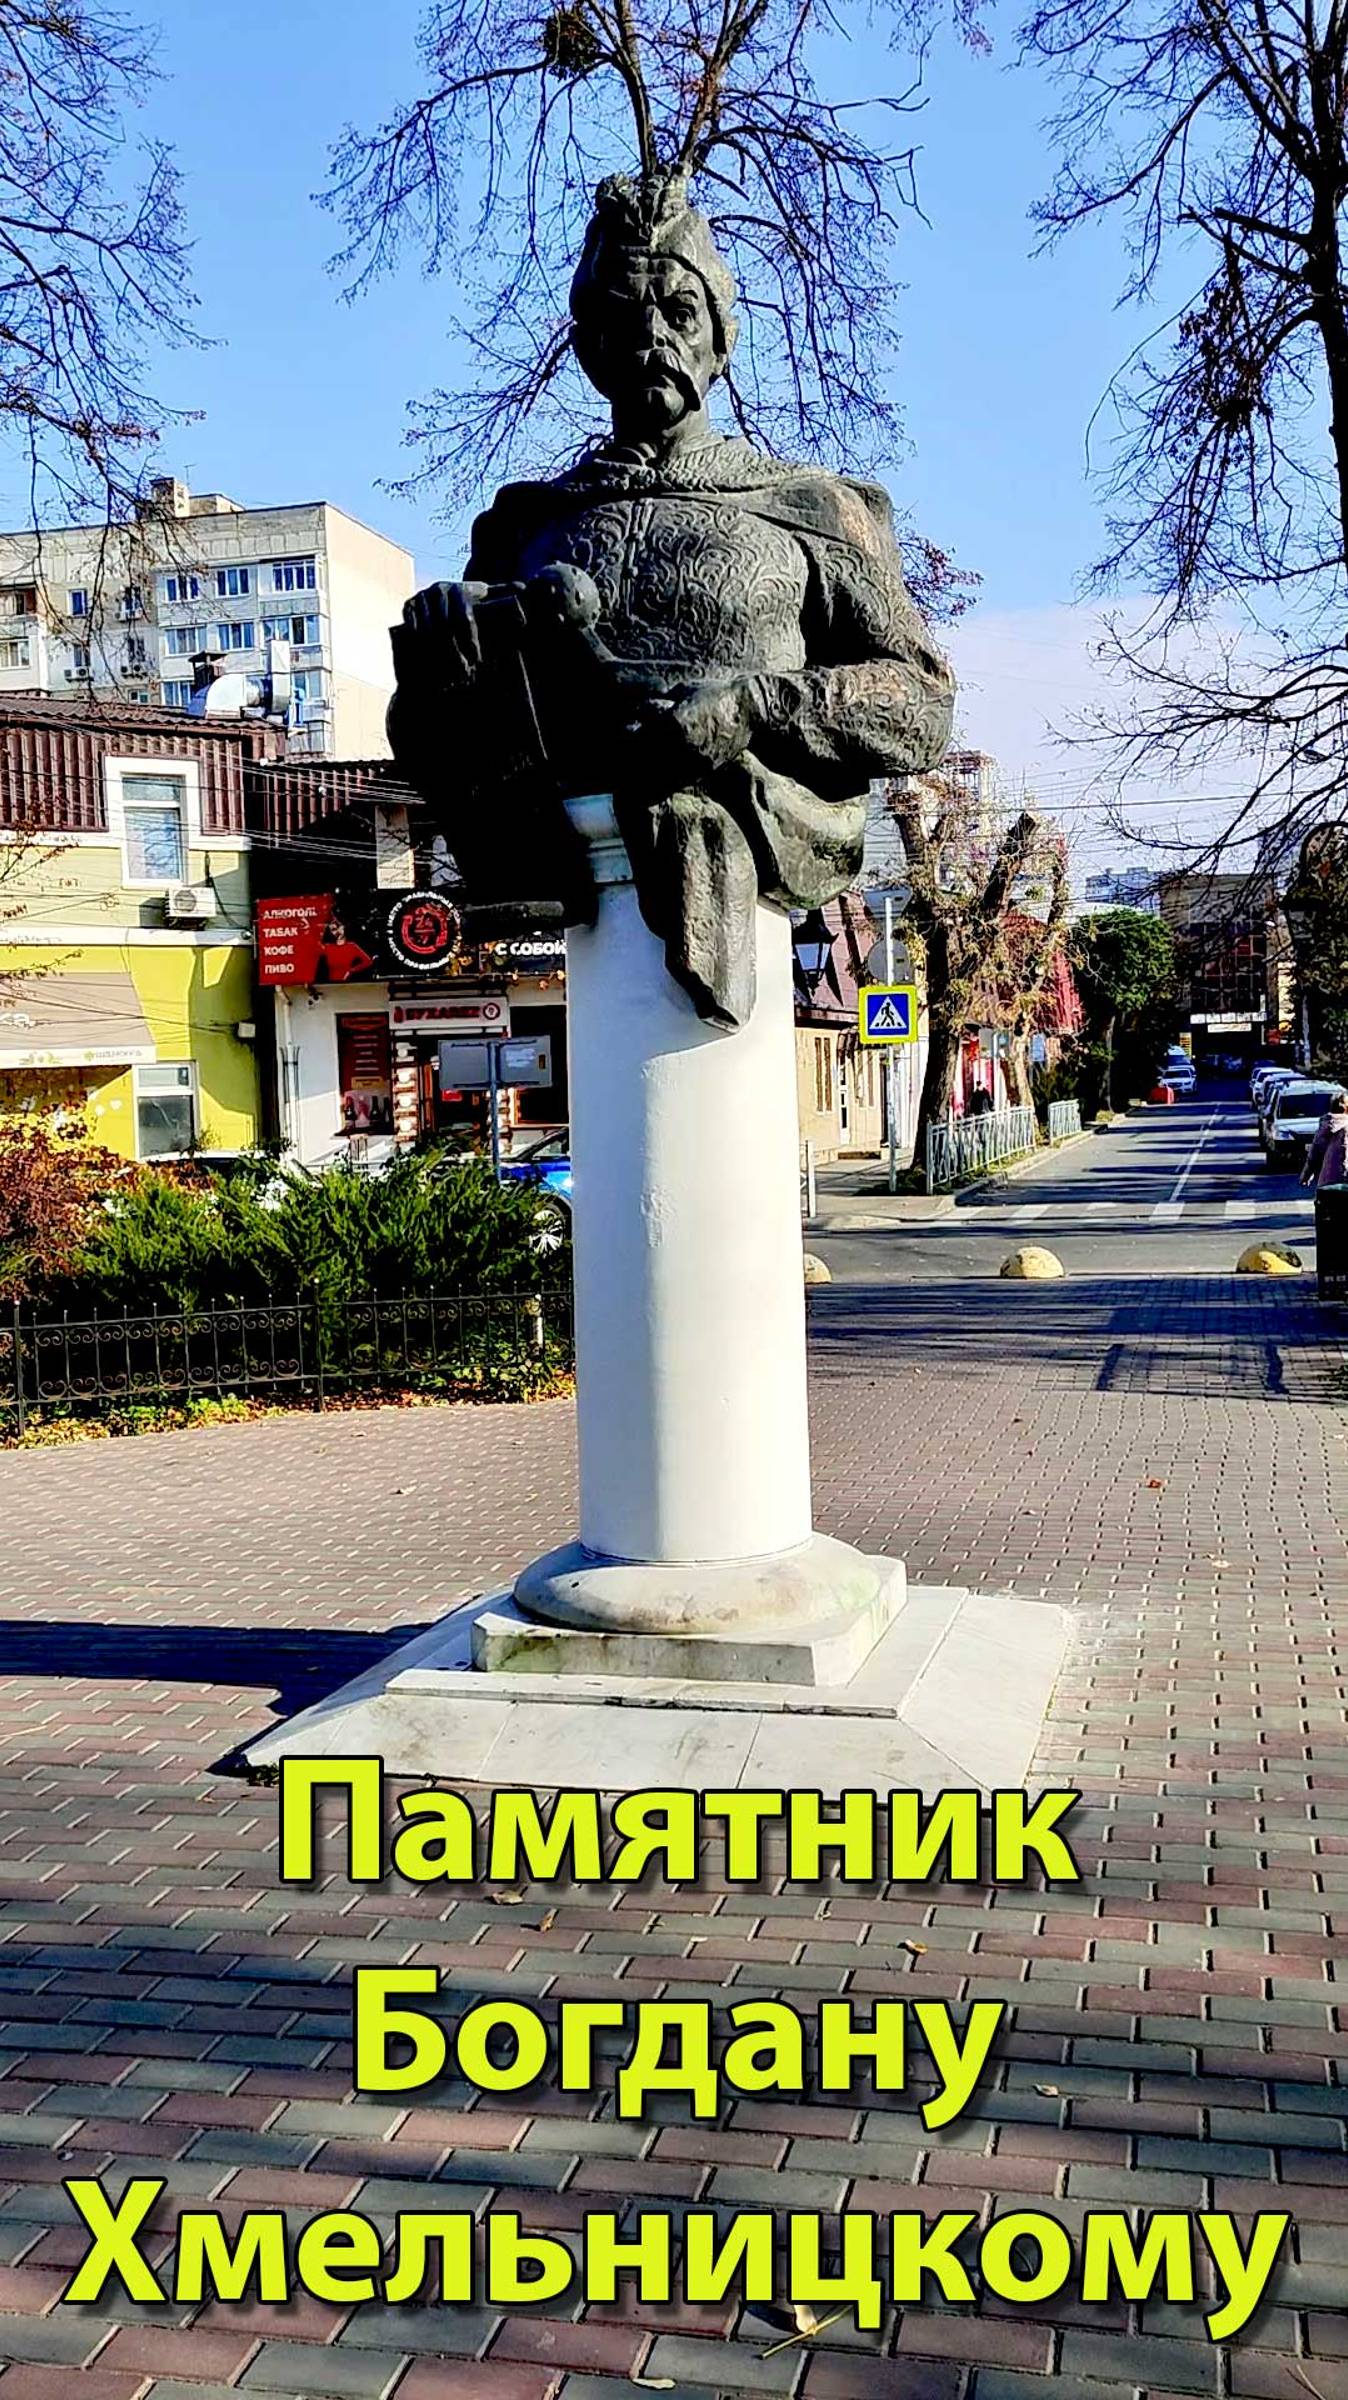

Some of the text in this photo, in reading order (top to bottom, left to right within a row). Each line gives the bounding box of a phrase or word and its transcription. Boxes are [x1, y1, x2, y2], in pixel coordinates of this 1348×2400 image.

[262, 907, 318, 920] АЛКОГОЛЬ
[262, 927, 298, 938] ТАБАК
[264, 945, 294, 956] КОФЕ
[495, 940, 567, 956] С СОБОЙ
[265, 963, 295, 974] ПИВО
